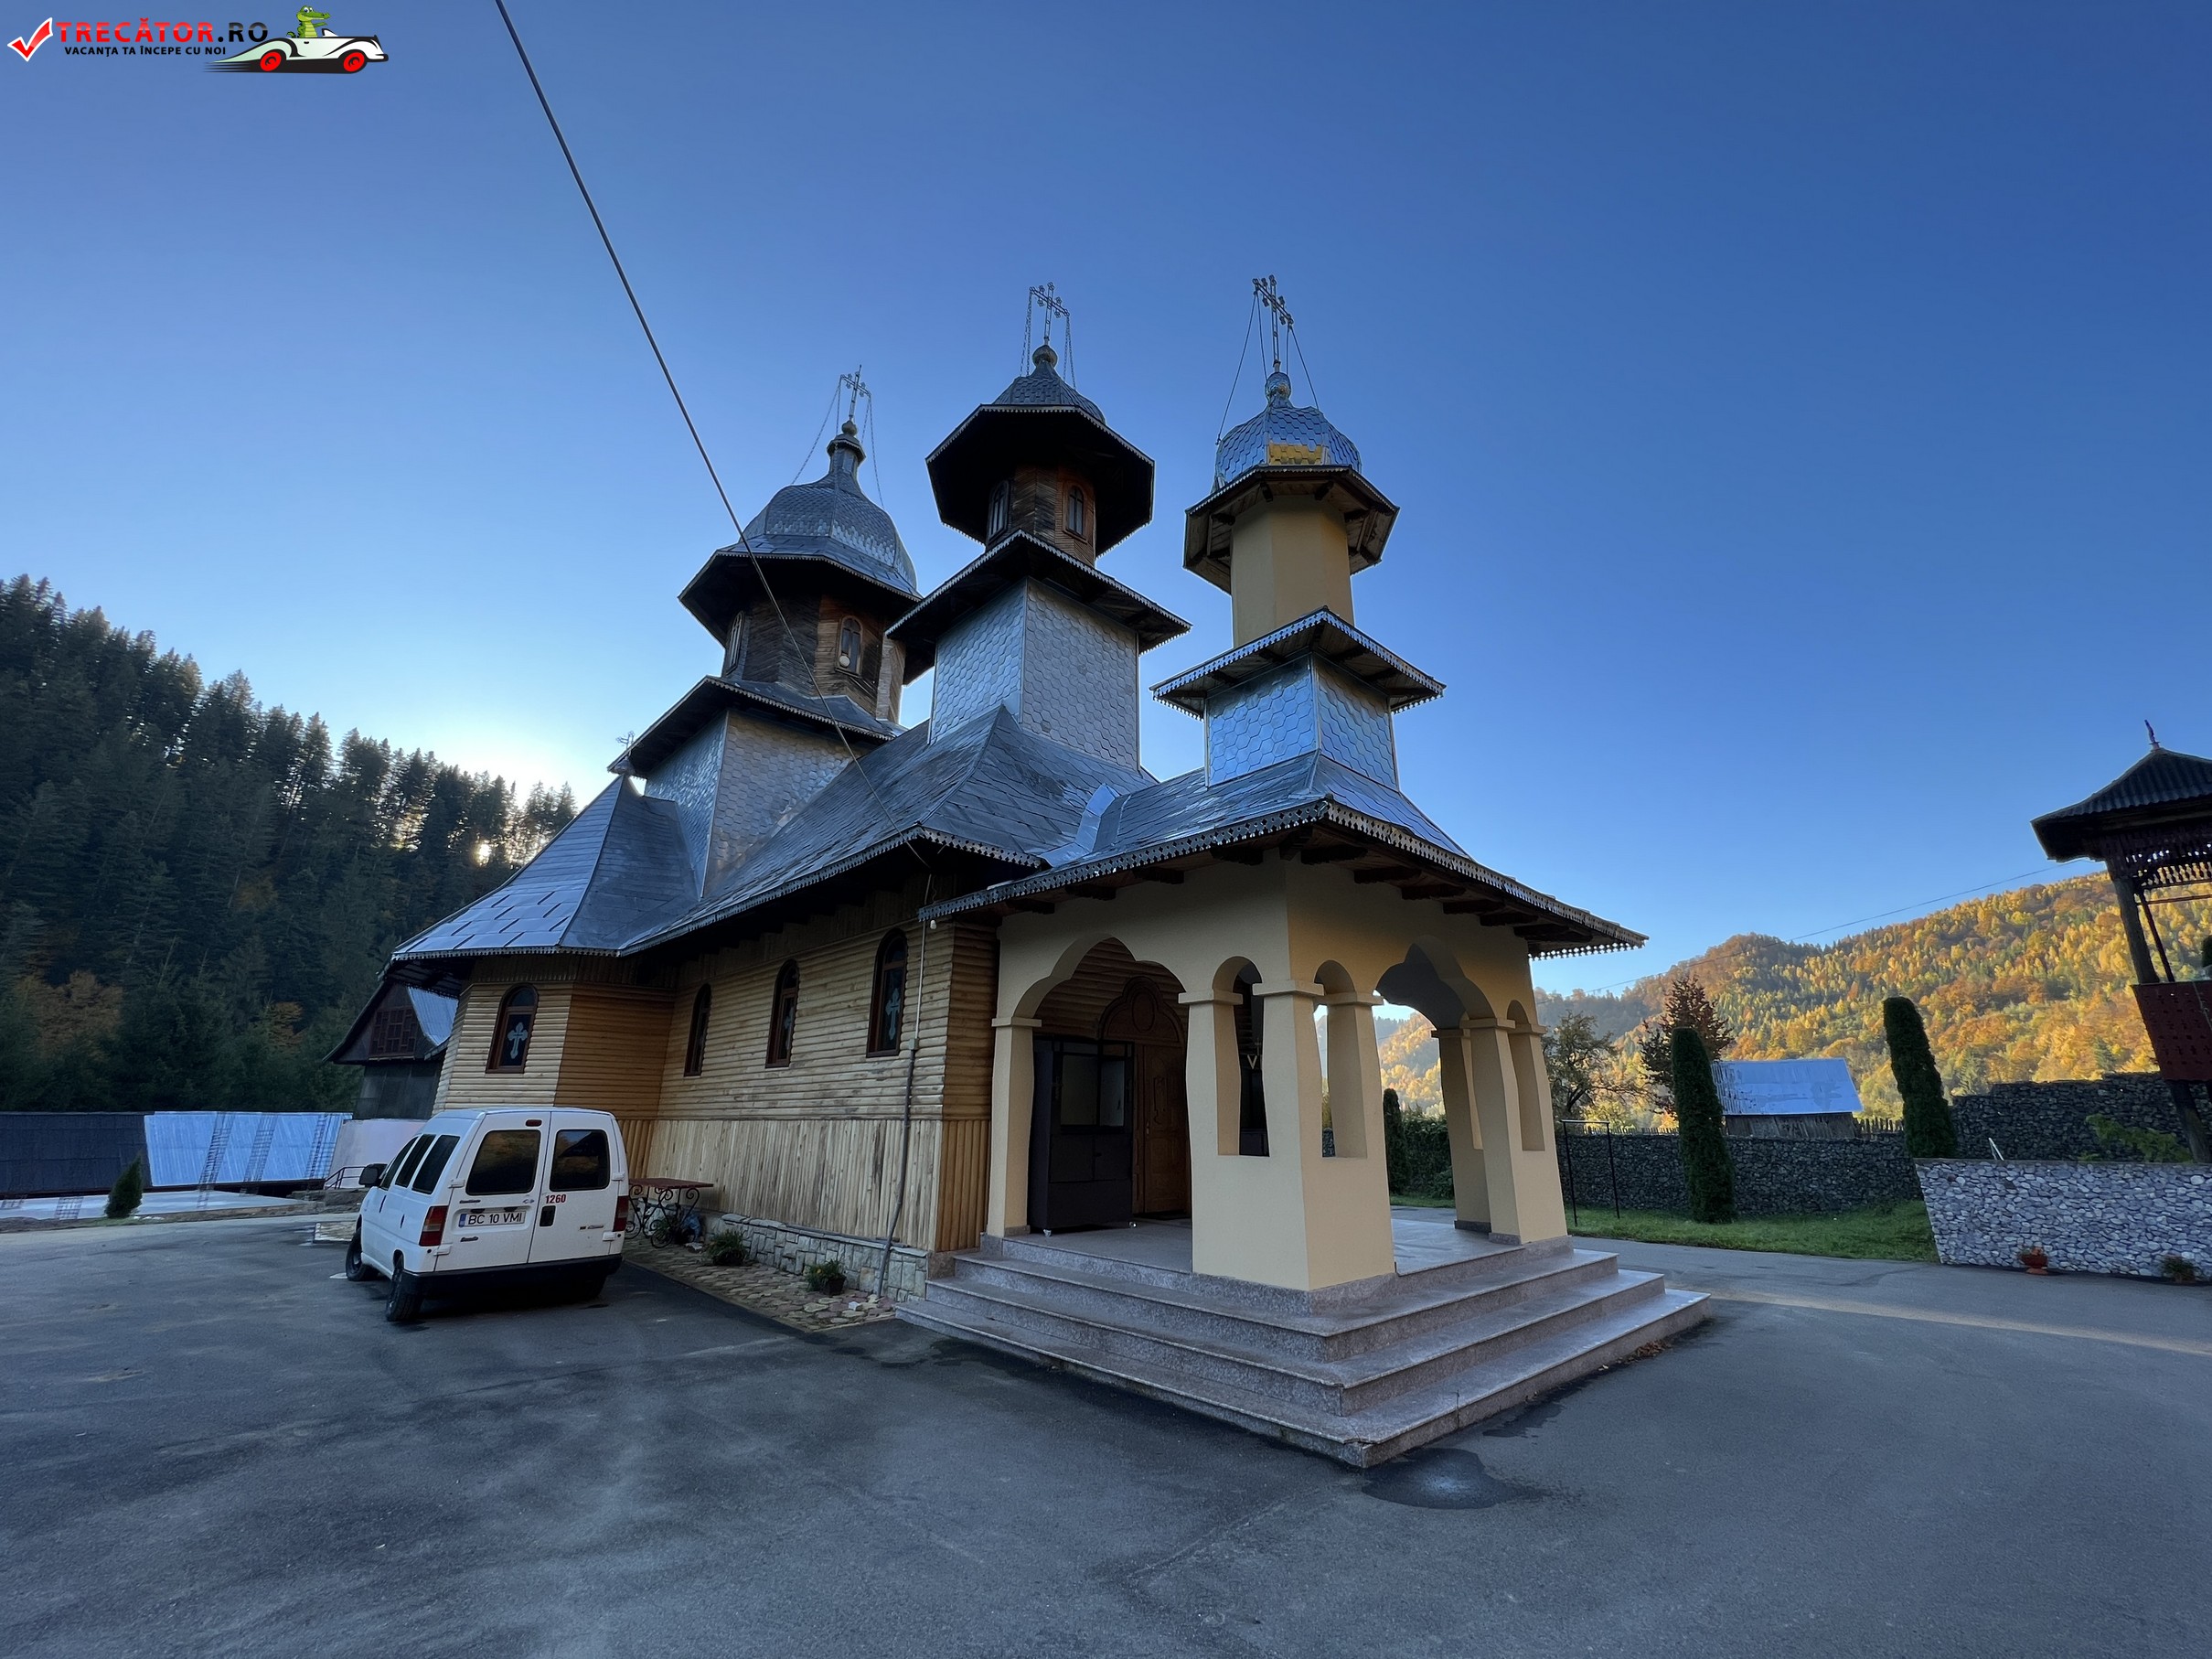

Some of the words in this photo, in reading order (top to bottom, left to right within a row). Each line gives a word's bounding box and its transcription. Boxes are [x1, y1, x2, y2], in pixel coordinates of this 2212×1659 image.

[545, 1193, 567, 1204] 1260
[467, 1215, 486, 1225] BC
[489, 1214, 500, 1224] 10
[503, 1212, 522, 1223] VMI
